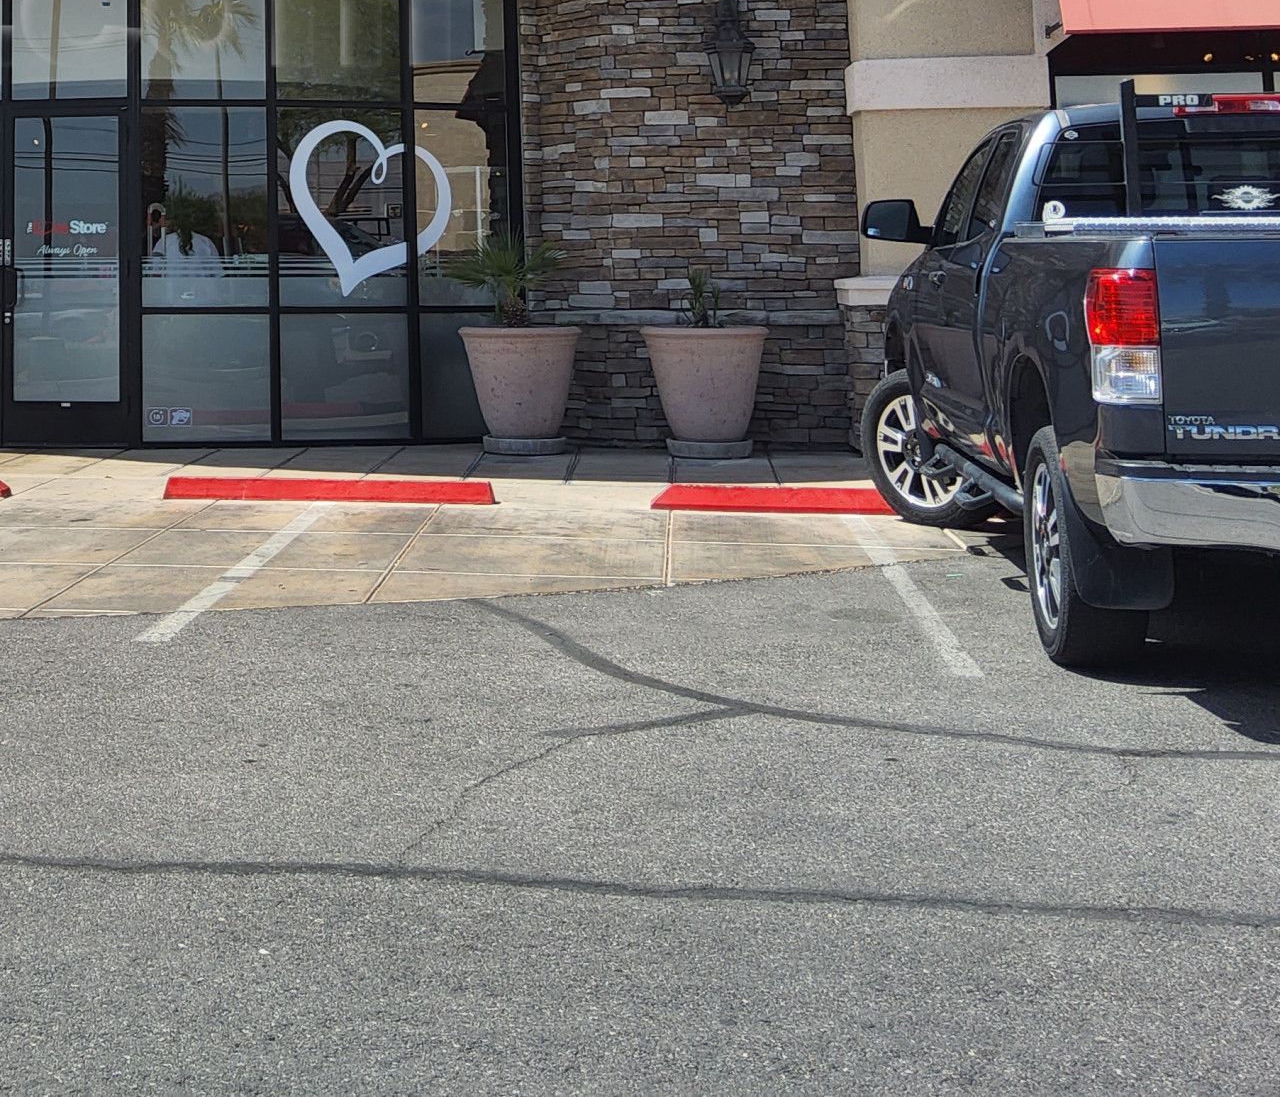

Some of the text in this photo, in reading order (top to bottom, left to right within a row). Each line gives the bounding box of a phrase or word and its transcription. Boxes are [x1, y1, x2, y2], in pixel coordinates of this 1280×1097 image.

[1158, 94, 1199, 106] PRO
[69, 220, 107, 234] Store
[36, 243, 98, 257] Always Open
[1168, 415, 1216, 425] TOYOTA
